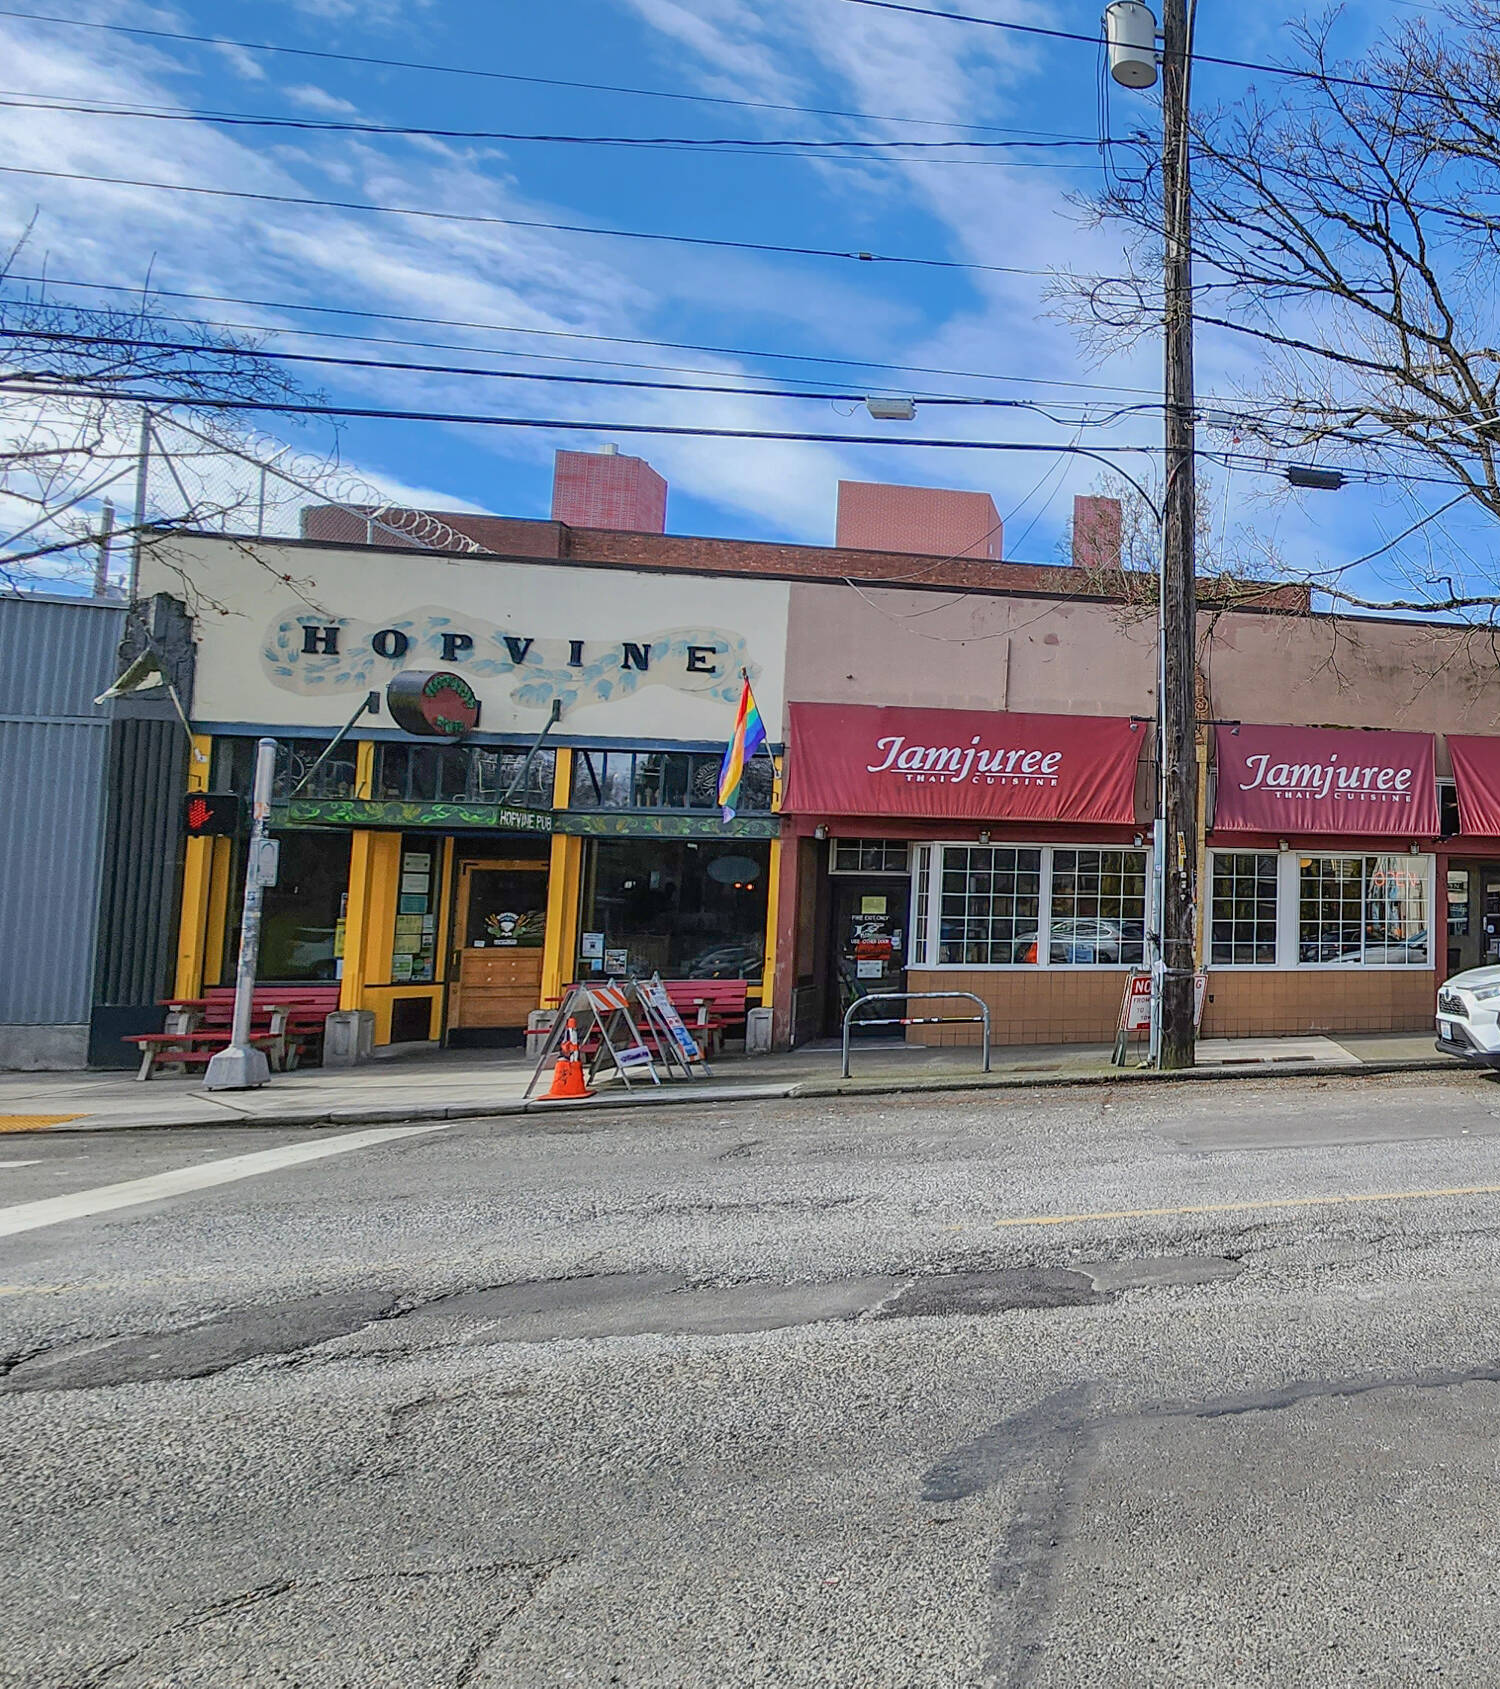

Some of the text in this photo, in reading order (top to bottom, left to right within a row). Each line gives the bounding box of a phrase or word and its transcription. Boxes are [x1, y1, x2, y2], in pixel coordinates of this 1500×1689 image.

[301, 625, 717, 673] HOPVINE
[867, 735, 1062, 783] Jamjuree
[906, 774, 1058, 787] THAI CUISINE
[1239, 754, 1412, 799] Jamjuree
[1275, 791, 1412, 802] THAI CUISINE
[536, 815, 552, 831] PUB
[1134, 980, 1152, 994] NO
